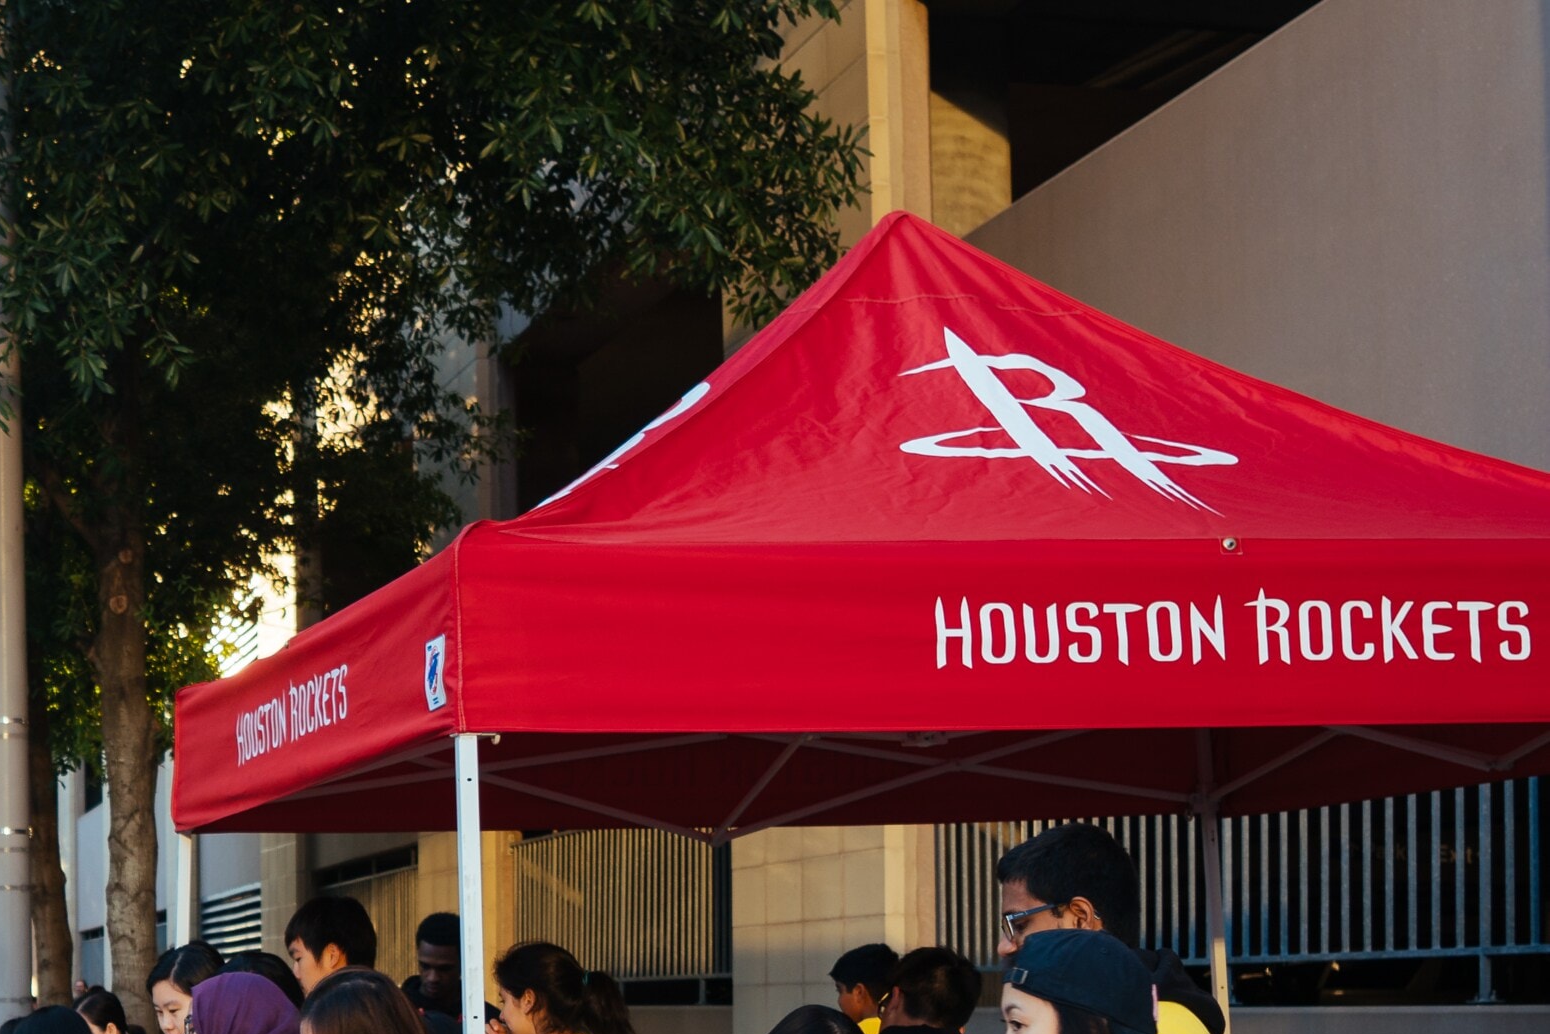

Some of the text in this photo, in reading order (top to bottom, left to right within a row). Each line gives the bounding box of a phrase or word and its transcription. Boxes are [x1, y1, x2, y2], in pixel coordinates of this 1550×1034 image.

[934, 587, 1532, 669] HOUSTON ROCKETS
[235, 689, 287, 767] HOUSTON
[288, 664, 349, 743] ROCKETS
